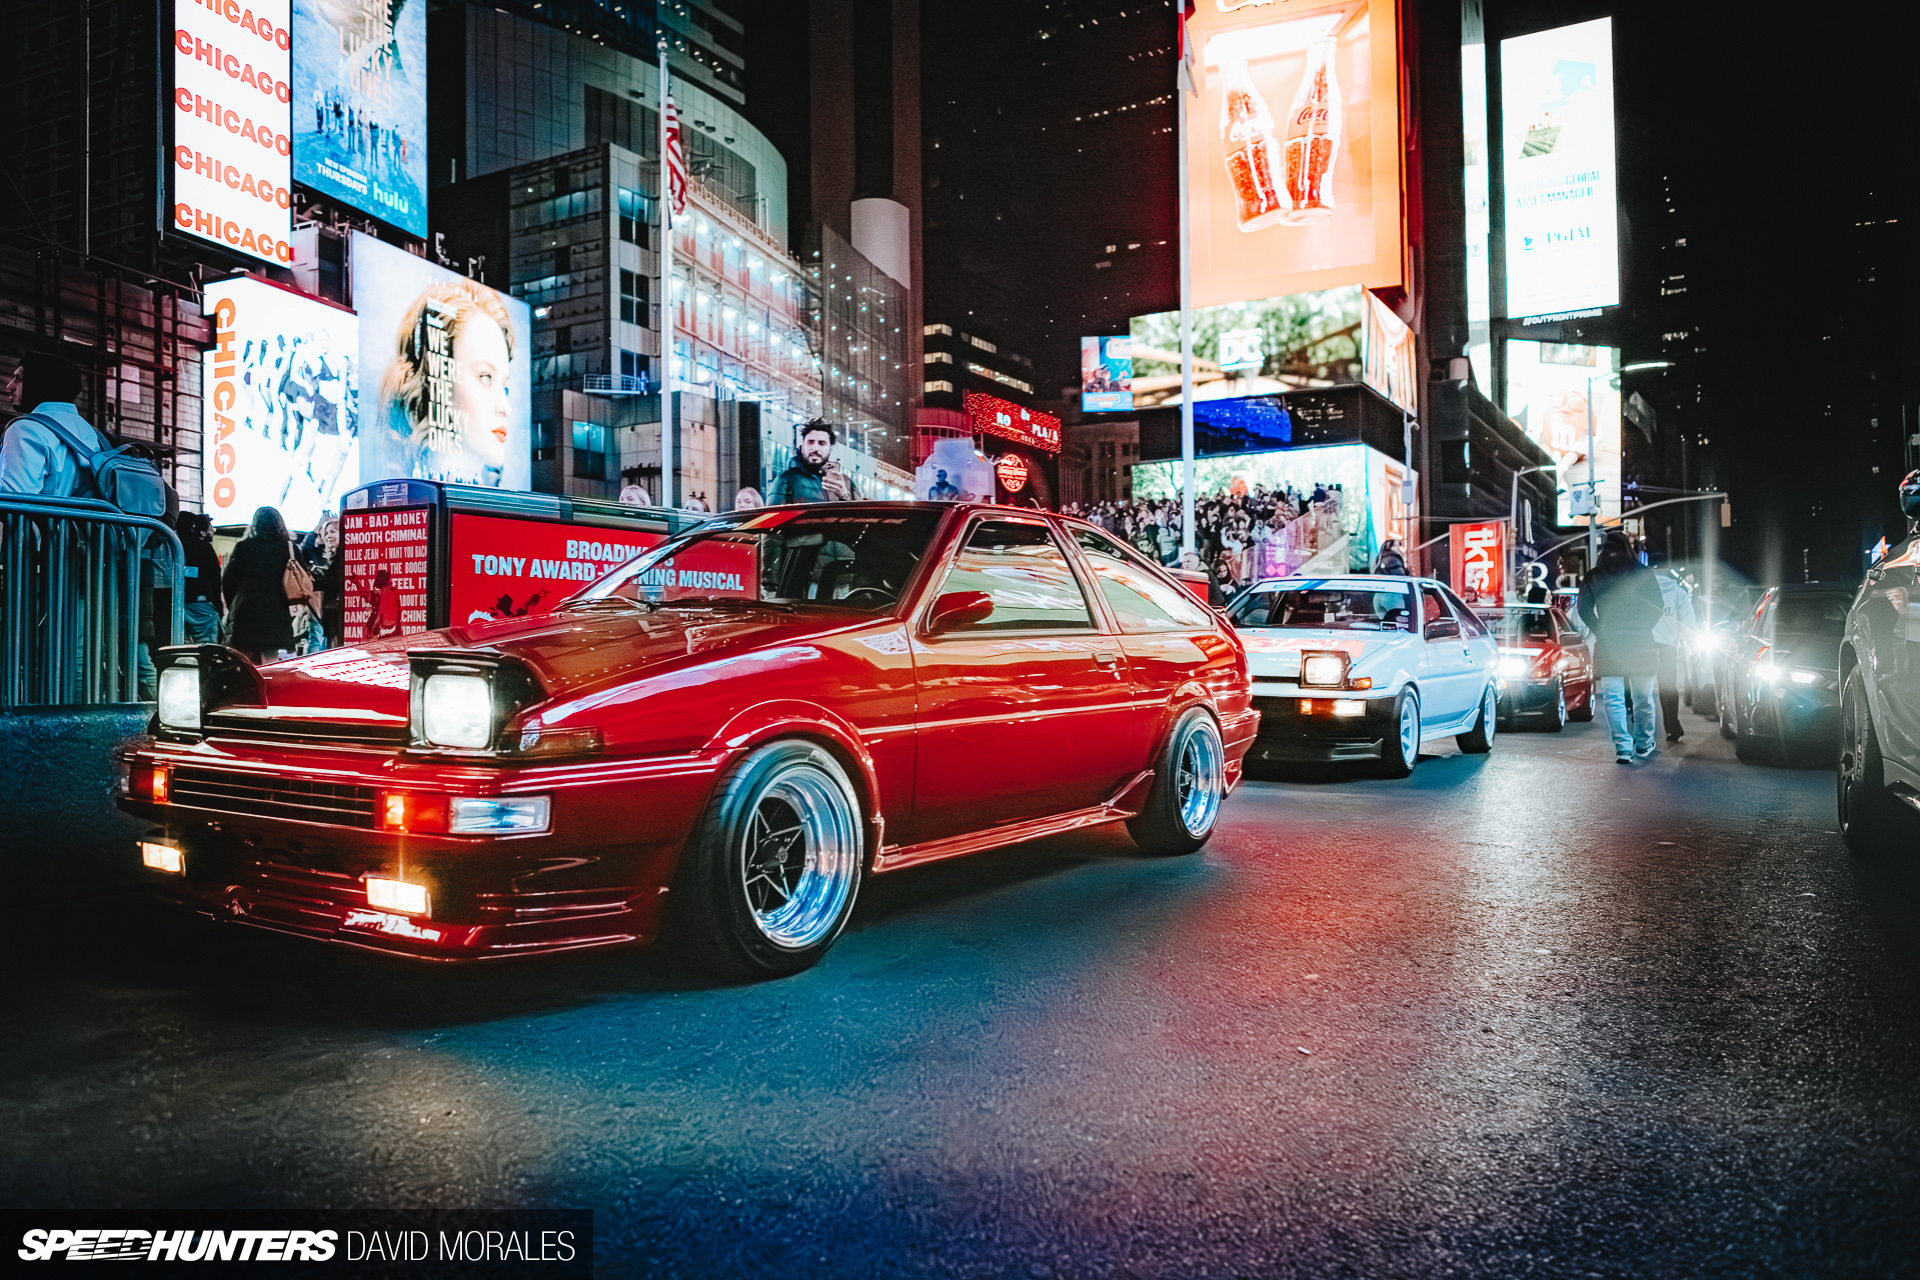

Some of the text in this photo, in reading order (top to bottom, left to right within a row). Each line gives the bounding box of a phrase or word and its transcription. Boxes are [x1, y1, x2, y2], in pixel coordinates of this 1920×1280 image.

[195, 0, 290, 51] ICAGO
[362, 11, 393, 57] THE
[175, 29, 290, 104] CHICAGO
[339, 25, 393, 81] LUCKY
[175, 87, 290, 157] CHICAGO
[175, 145, 290, 210] CHICAGO
[373, 181, 409, 214] hulu
[1516, 187, 1594, 208] ASSET MANAGER
[175, 203, 290, 263] CHICAGO
[427, 325, 448, 357] WE
[427, 351, 464, 386] WERE
[214, 298, 236, 508] CHICAGO
[427, 376, 453, 407] THE
[428, 401, 470, 436] LUCKY
[428, 427, 463, 457] ONES
[345, 511, 428, 530] JAM BAD MONEY
[345, 528, 428, 545] SMOOTH CRIMINAL
[345, 548, 363, 561] BILLIE
[363, 547, 379, 560] JEAN
[388, 546, 403, 559] WANT
[403, 546, 414, 558] YOU
[345, 563, 367, 576] BLAME
[369, 564, 376, 576] IT
[390, 562, 402, 575] THE
[404, 561, 428, 574] BOOGIE
[1464, 527, 1497, 591] tkts
[392, 577, 415, 590] FEEL
[418, 577, 427, 589] IT
[472, 554, 526, 577] TONY
[679, 570, 745, 592] MUSICAL
[344, 596, 361, 608] THEY
[344, 610, 427, 623] DANC CHINE
[344, 626, 363, 639] MAN
